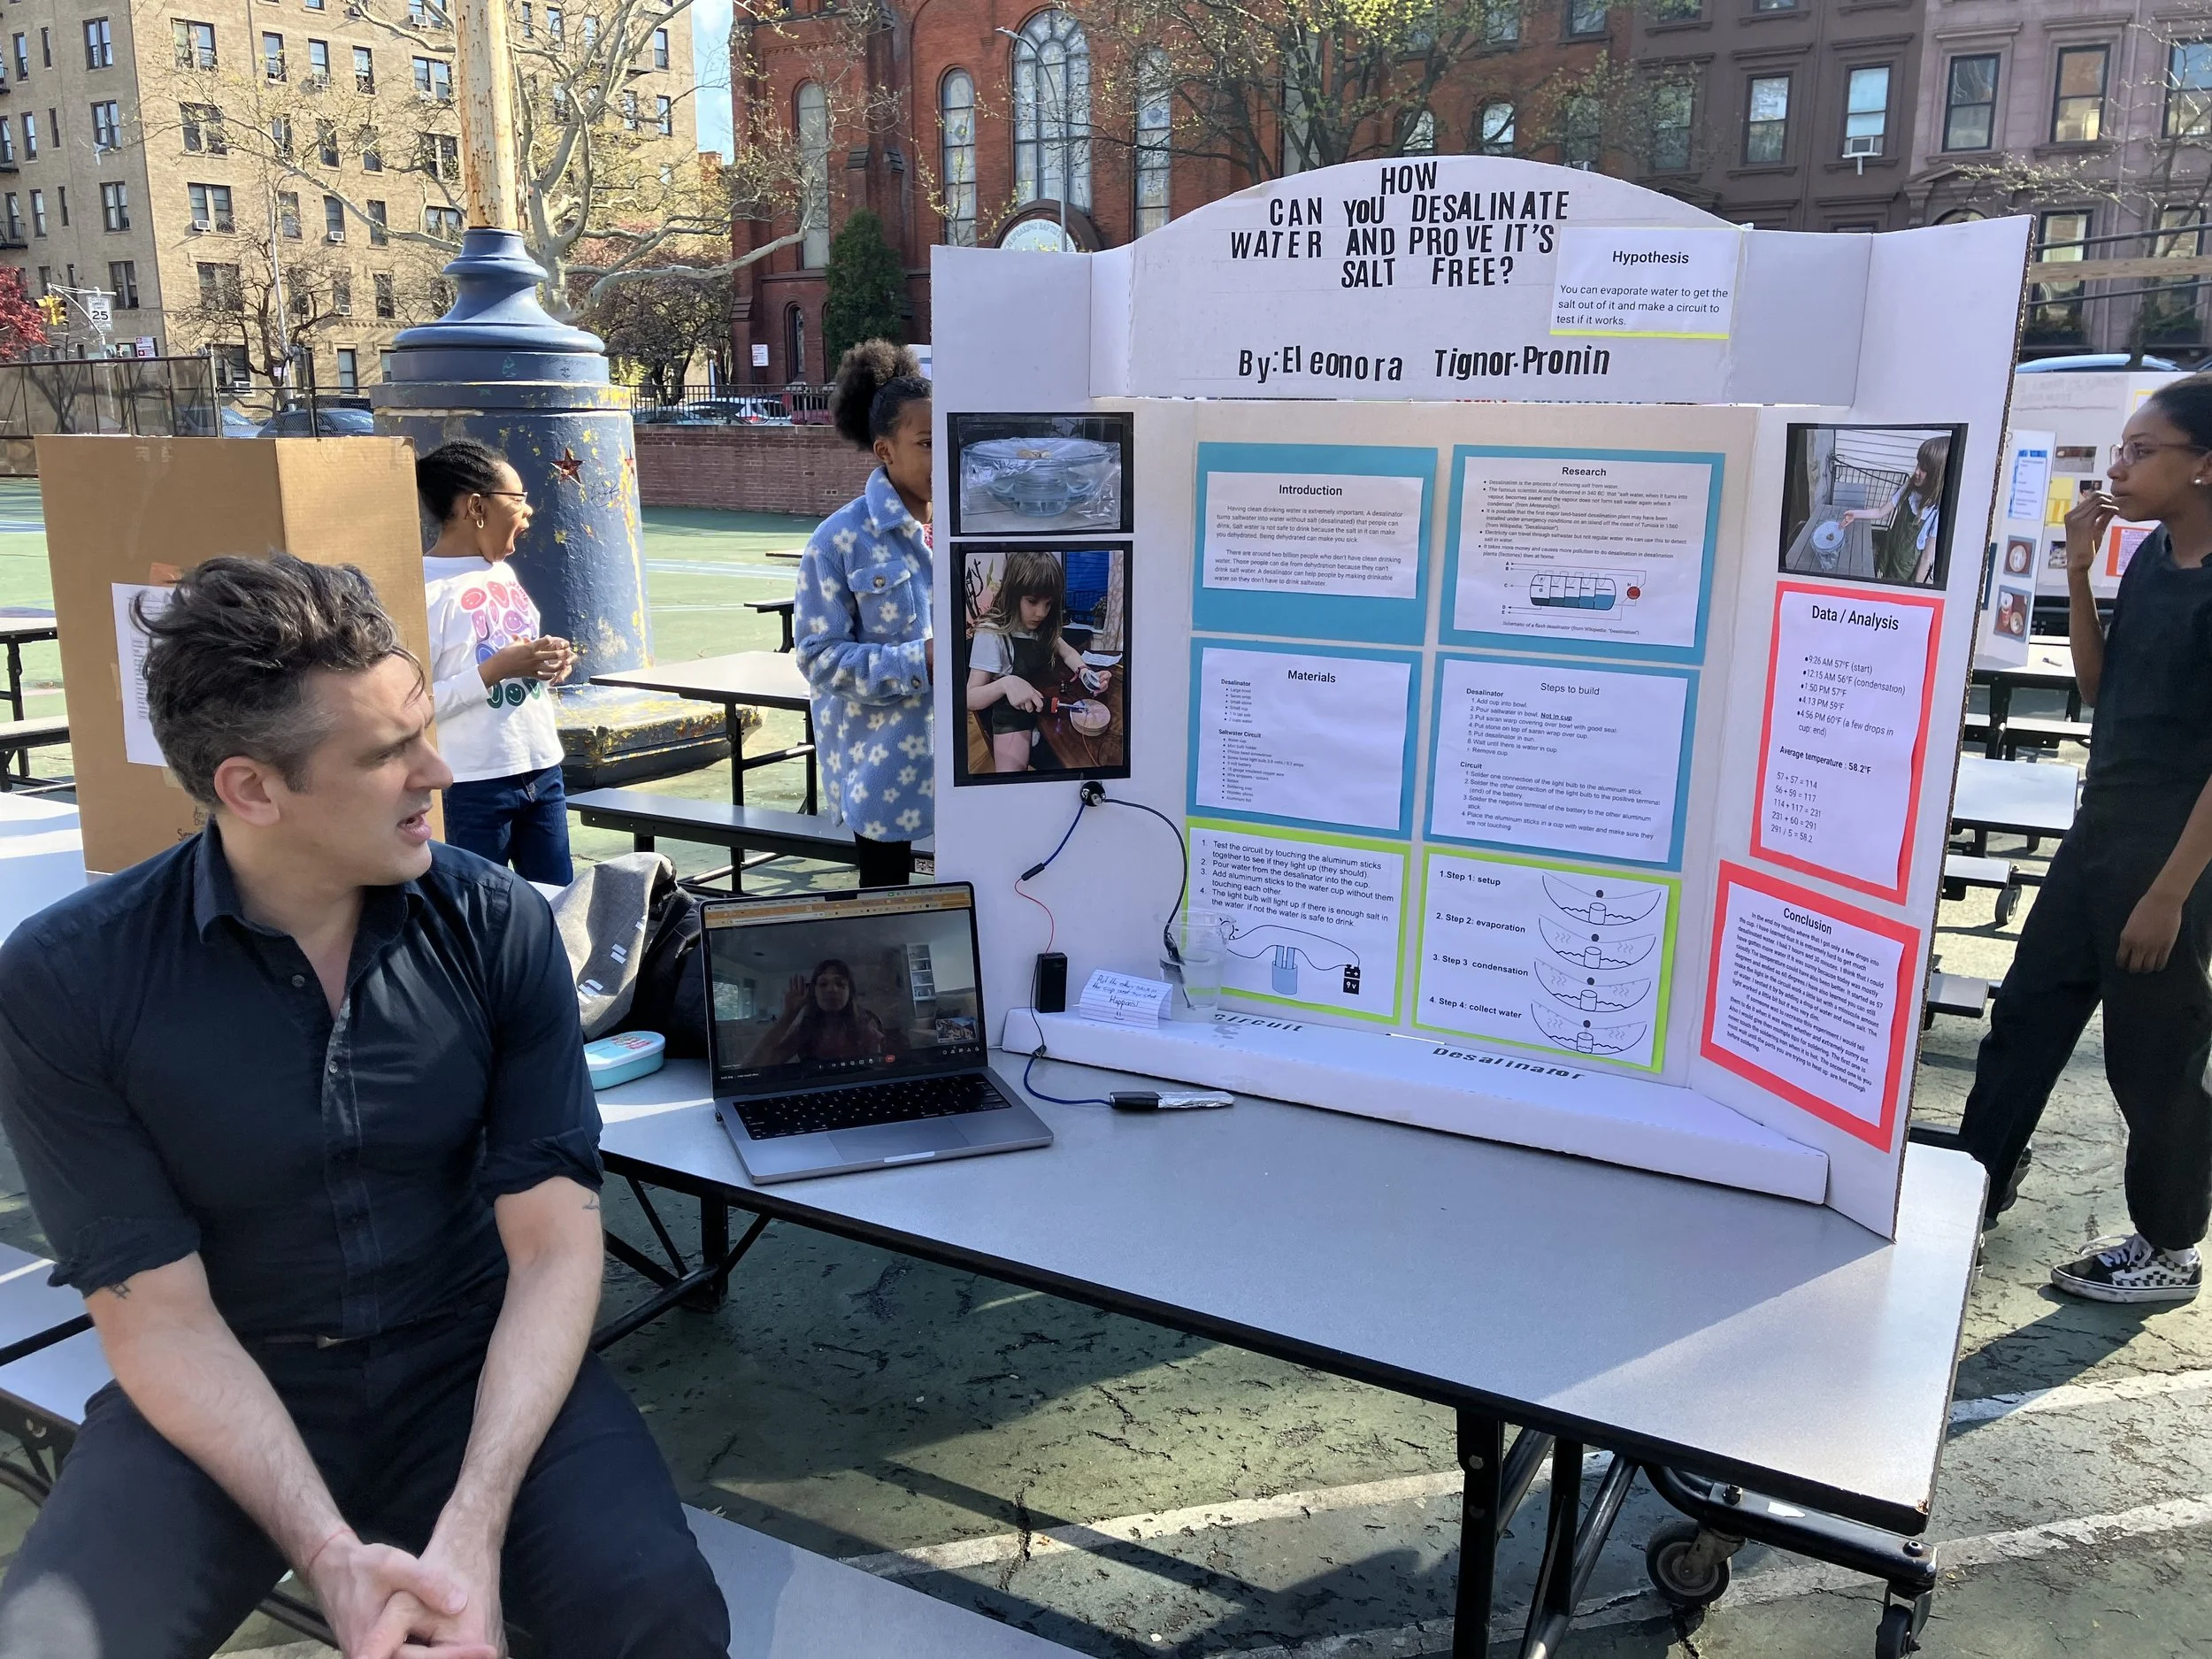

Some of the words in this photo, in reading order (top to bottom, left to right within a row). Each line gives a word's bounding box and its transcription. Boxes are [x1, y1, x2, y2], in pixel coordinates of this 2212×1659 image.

[1381, 161, 1438, 195] HOW
[1270, 197, 1322, 227] CAN
[1412, 191, 1569, 224] DESALINATE
[1231, 230, 1322, 258] WATER
[1346, 227, 1395, 257] AND
[1409, 225, 1493, 257] PROVE
[1504, 224, 1555, 254] IT'S
[1612, 250, 1689, 265] Hypothesis
[1341, 257, 1395, 288] SALT
[1432, 256, 1513, 287] FREE?
[1560, 284, 1578, 294] You
[1600, 287, 1648, 296] evaporate
[1650, 288, 1678, 296] water
[1681, 288, 1691, 296] to
[1693, 288, 1709, 299] get
[1712, 288, 1728, 297] the
[92, 311, 109, 320] 25
[1557, 299, 1575, 309] salt
[1578, 301, 1594, 310] out
[1595, 300, 1607, 310] of
[1608, 301, 1615, 310] it
[1617, 301, 1636, 311] and
[1638, 301, 1665, 311] make
[1676, 303, 1707, 312] circuit
[1709, 303, 1719, 312] to
[1556, 315, 1575, 324] test
[1577, 314, 1585, 324] if
[1586, 315, 1592, 324] it
[1594, 315, 1625, 325] works.
[1562, 466, 1606, 476] Research
[1279, 484, 1342, 495] Introduction
[1811, 604, 1838, 621] Data
[1847, 610, 1899, 632] Analysis
[1287, 669, 1336, 683] Materials
[1822, 657, 1834, 667] AM
[1850, 661, 1872, 675] (start)
[1220, 678, 1251, 687] Desalinator
[1466, 687, 1504, 697] Desalinator
[1540, 682, 1565, 694] Steps
[1567, 685, 1576, 694] to
[1578, 686, 1600, 695] build
[1824, 672, 1837, 682] AM
[1854, 676, 1906, 696] (condensation)
[1815, 712, 1826, 723] PM
[1843, 718, 1851, 728] (a
[1851, 718, 1863, 729] few
[1863, 722, 1886, 735] drops
[1886, 727, 1894, 737] in
[1779, 745, 1804, 759] Average
[1805, 752, 1843, 768] temperature
[1212, 850, 1241, 860] together
[1272, 858, 1288, 869] they
[1290, 860, 1305, 870] light
[1318, 864, 1338, 875] (they
[1213, 840, 1228, 849] Test
[1229, 842, 1240, 851] the
[1264, 848, 1274, 856] by
[1275, 849, 1306, 861] touching
[1308, 853, 1320, 862] the
[1321, 855, 1358, 866] aluminum
[1359, 861, 1381, 870] sticks
[1212, 859, 1230, 868] Pour
[1252, 864, 1269, 874] from
[1283, 870, 1324, 881] desalinator
[1325, 875, 1339, 884] into
[1340, 877, 1353, 886] the
[1477, 877, 1501, 887] setup
[1212, 869, 1226, 878] Add
[1228, 872, 1263, 882] aluminum
[1263, 877, 1285, 886] sticks
[1294, 880, 1307, 889] the
[1346, 889, 1373, 899] without
[1374, 892, 1394, 902] them
[1211, 887, 1225, 897] The
[1227, 890, 1242, 900] light
[1243, 893, 1259, 902] bulb
[1272, 897, 1288, 907] light
[1307, 902, 1326, 912] there
[1335, 908, 1364, 919] enough
[1445, 913, 1464, 925] Step
[1476, 919, 1525, 933] evaporation
[1783, 907, 1832, 934] Conclusion
[1441, 955, 1461, 965] Step
[1471, 961, 1528, 976] condensation
[1439, 997, 1457, 1008] Step
[1469, 1004, 1496, 1014] collect
[1498, 1010, 1522, 1018] water
[1432, 1048, 1586, 1079] Desalinator
